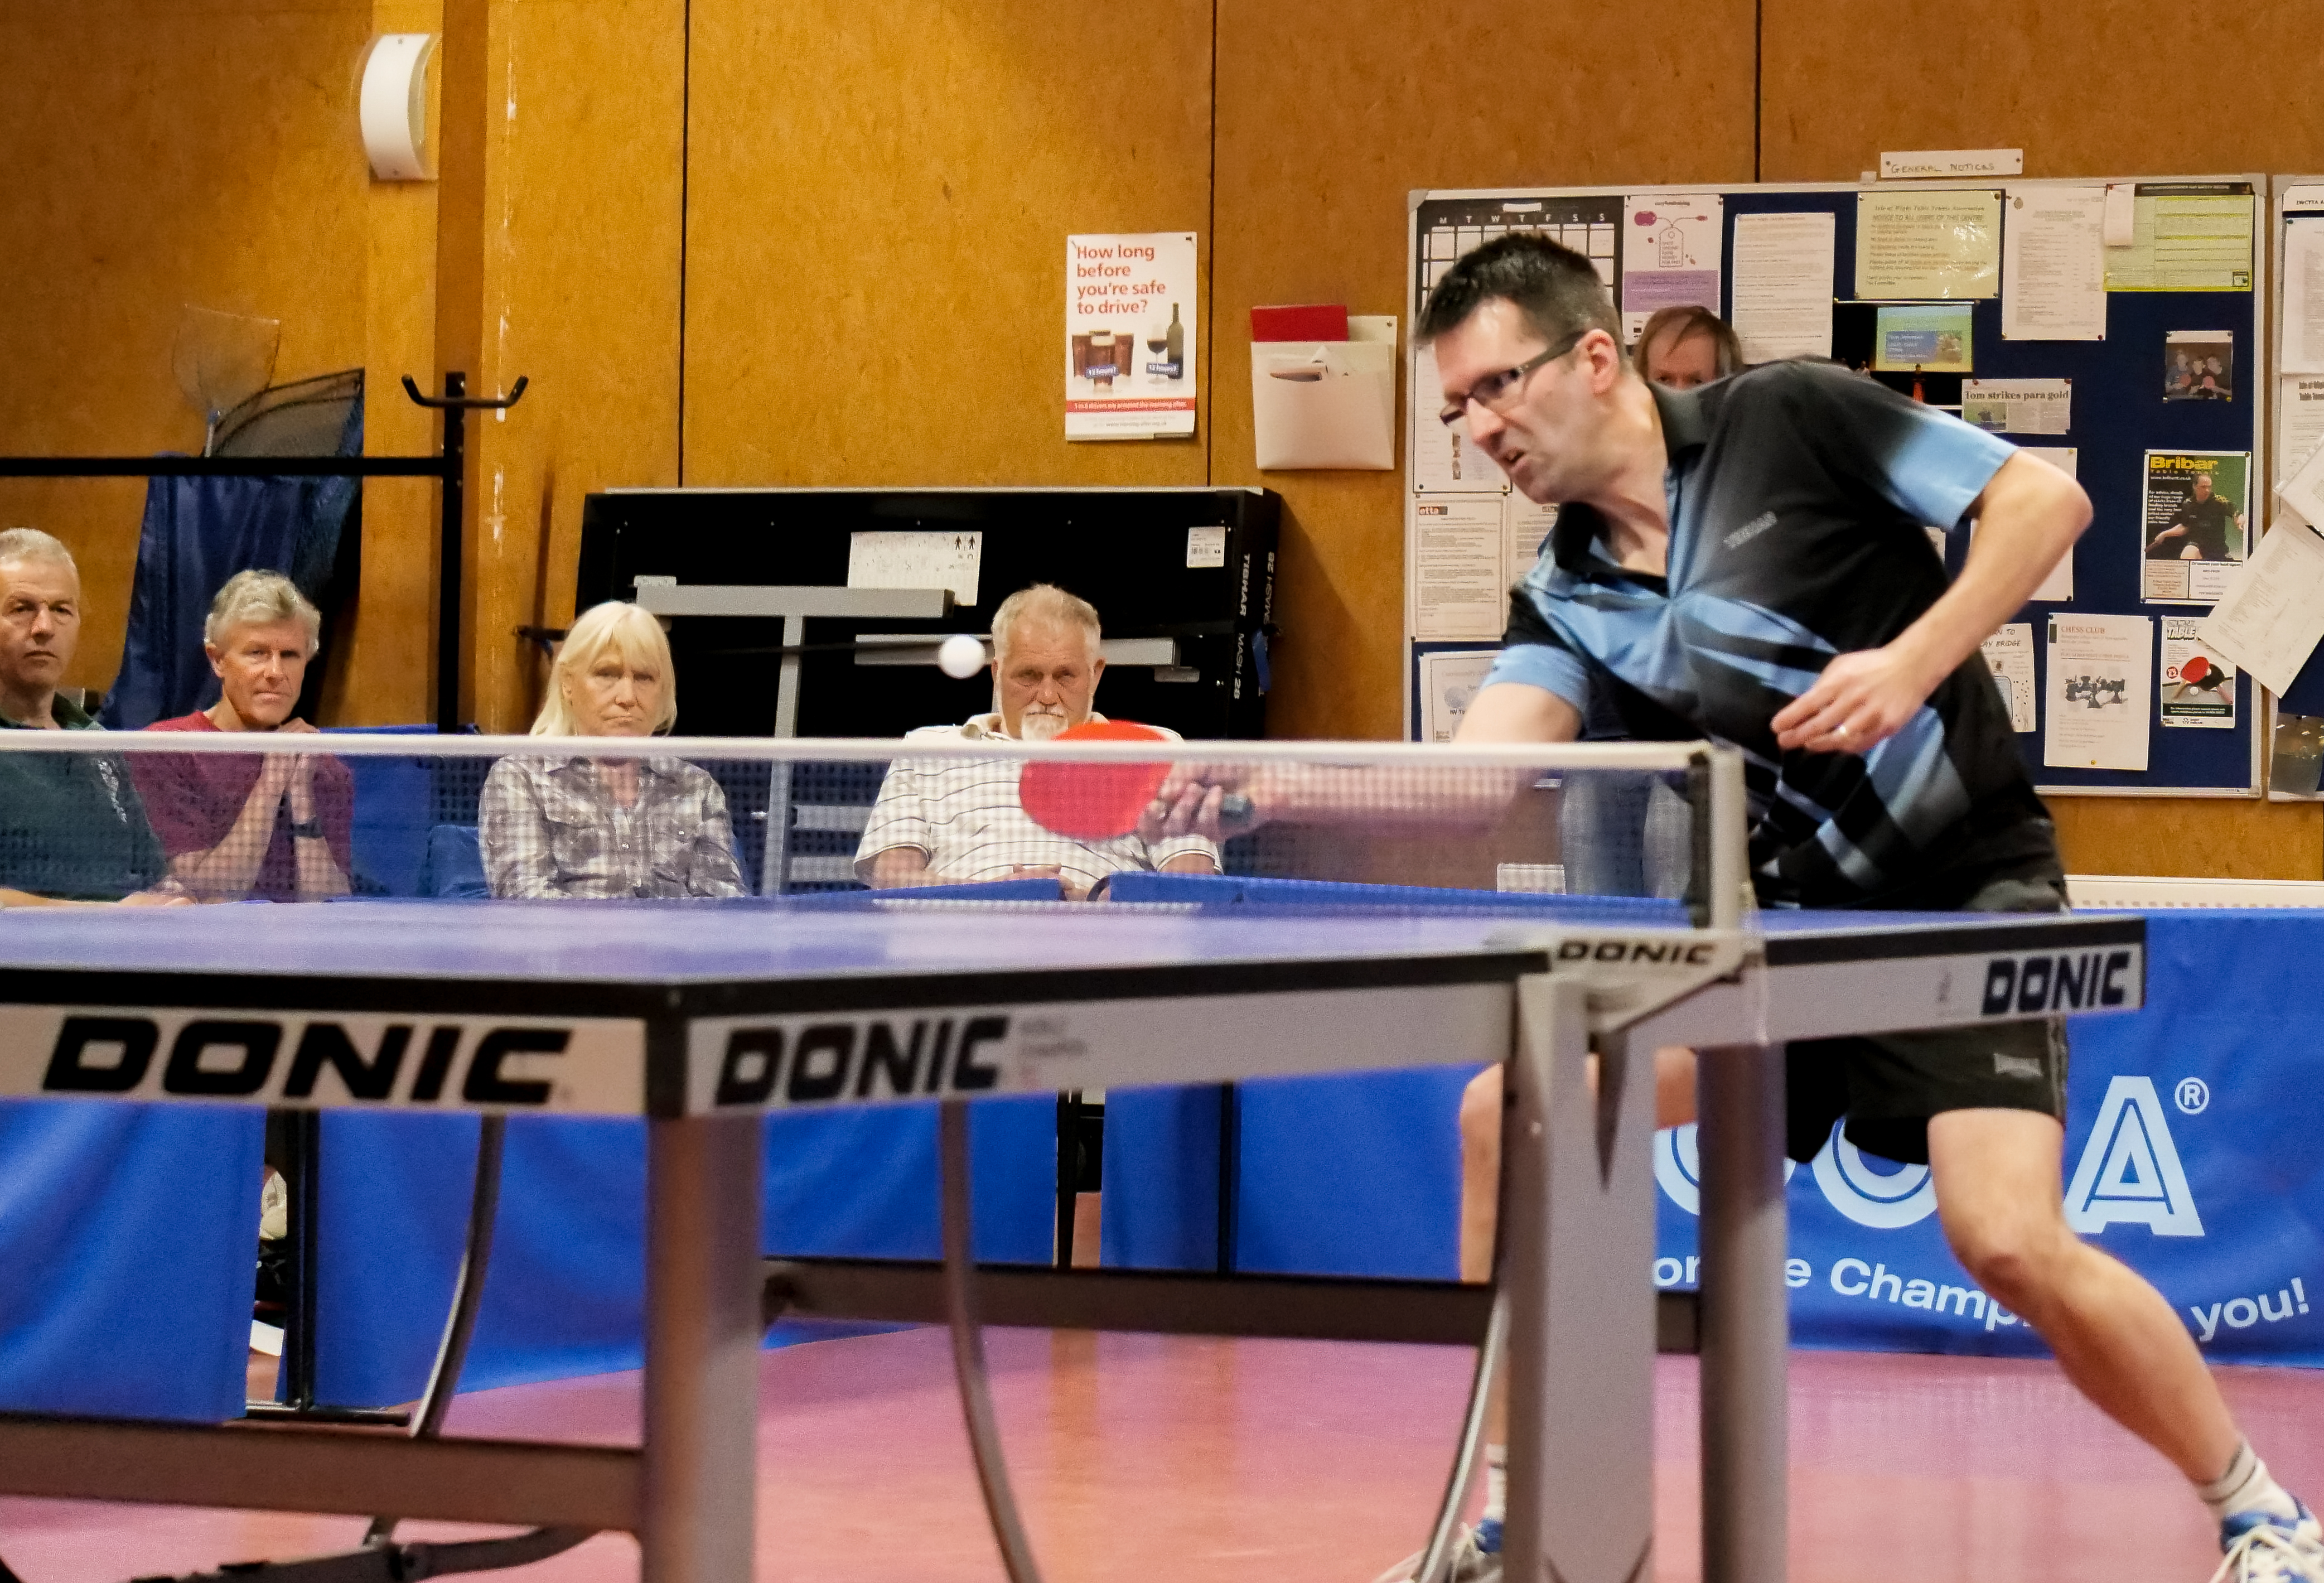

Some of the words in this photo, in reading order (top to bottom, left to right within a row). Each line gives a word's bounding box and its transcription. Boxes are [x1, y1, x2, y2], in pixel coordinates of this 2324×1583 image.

[1891, 164, 1941, 173] GENERAL
[1466, 215, 1473, 224] T
[1491, 215, 1501, 223] W
[1518, 214, 1525, 223] T
[1545, 213, 1552, 222] F
[1572, 213, 1579, 223] S
[1598, 213, 1606, 222] S
[1077, 245, 1113, 259] How
[1118, 244, 1154, 261] long
[1077, 263, 1131, 277] before
[1077, 283, 1128, 300] you're
[1132, 279, 1166, 295] safe
[1078, 302, 1094, 314] to
[1098, 300, 1148, 313] drive?
[1965, 391, 1985, 399] Tom
[1988, 391, 2021, 399] strikes
[2024, 392, 2045, 401] para
[2047, 390, 2069, 401] gold
[2150, 456, 2219, 470] Bribar
[1267, 551, 1275, 573] 28
[1240, 553, 1250, 617] TIBHAR
[2167, 626, 2196, 639] TABLE
[1234, 677, 1242, 699] 28
[1559, 939, 1718, 964] DONIC
[1981, 950, 2130, 1015] DONIC
[42, 1015, 574, 1104] DONIC
[716, 1015, 1011, 1107] DONIC
[1830, 1258, 2031, 1332] Champ
[2191, 1277, 2309, 1341] you!
